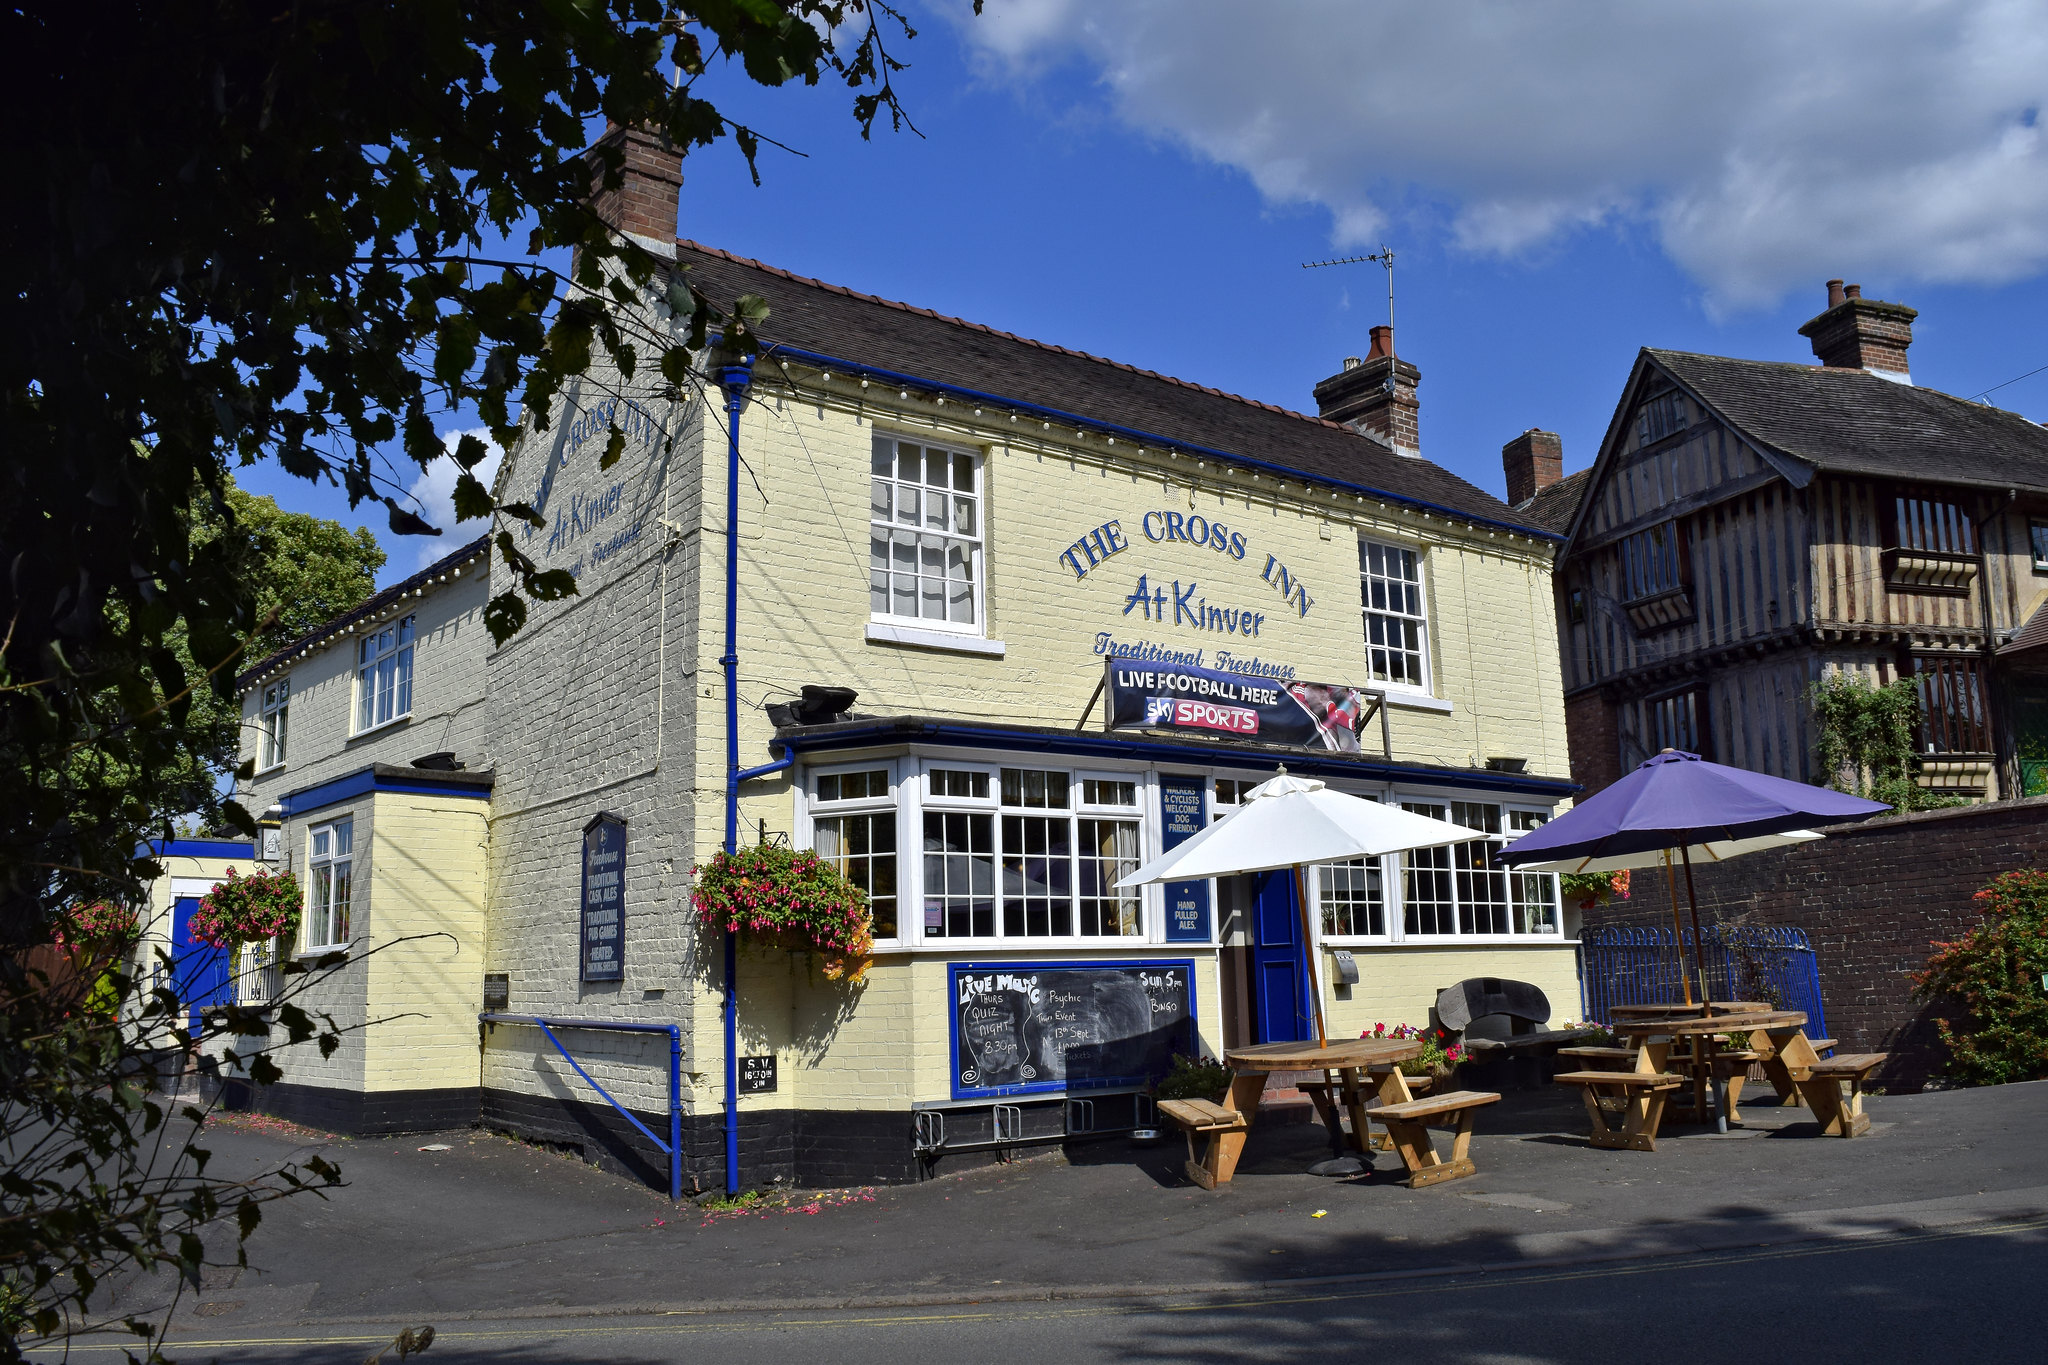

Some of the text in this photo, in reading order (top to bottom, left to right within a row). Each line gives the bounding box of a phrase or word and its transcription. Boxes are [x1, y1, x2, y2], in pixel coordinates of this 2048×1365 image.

[560, 396, 617, 467] CROSS
[546, 480, 624, 560] At Kinver
[1058, 510, 1315, 619] THE CROSS INN
[1122, 573, 1265, 639] At Kinver
[1093, 632, 1296, 679] Traditional Freehouse
[1118, 670, 1278, 706] LIVE FOOTBALL HERE
[1147, 698, 1256, 730] sky SPORTS
[1166, 786, 1196, 795] WALKERS
[1164, 794, 1200, 805] & CYCLISTS
[1175, 814, 1190, 823] DOG
[588, 871, 619, 889] TRADITIONAL
[588, 887, 618, 904] CASK ALES
[1177, 901, 1196, 910] HAND
[586, 908, 619, 926] TRADITIONAL
[1174, 911, 1198, 920] PULLED
[588, 924, 618, 941] PUB GAMES
[1140, 971, 1163, 988] Sun
[977, 993, 1004, 1005] THURS
[1049, 990, 1081, 1009] Psychic
[971, 1006, 999, 1024] QUIZ
[1055, 1010, 1077, 1021] Event
[1070, 1025, 1090, 1042] Sept
